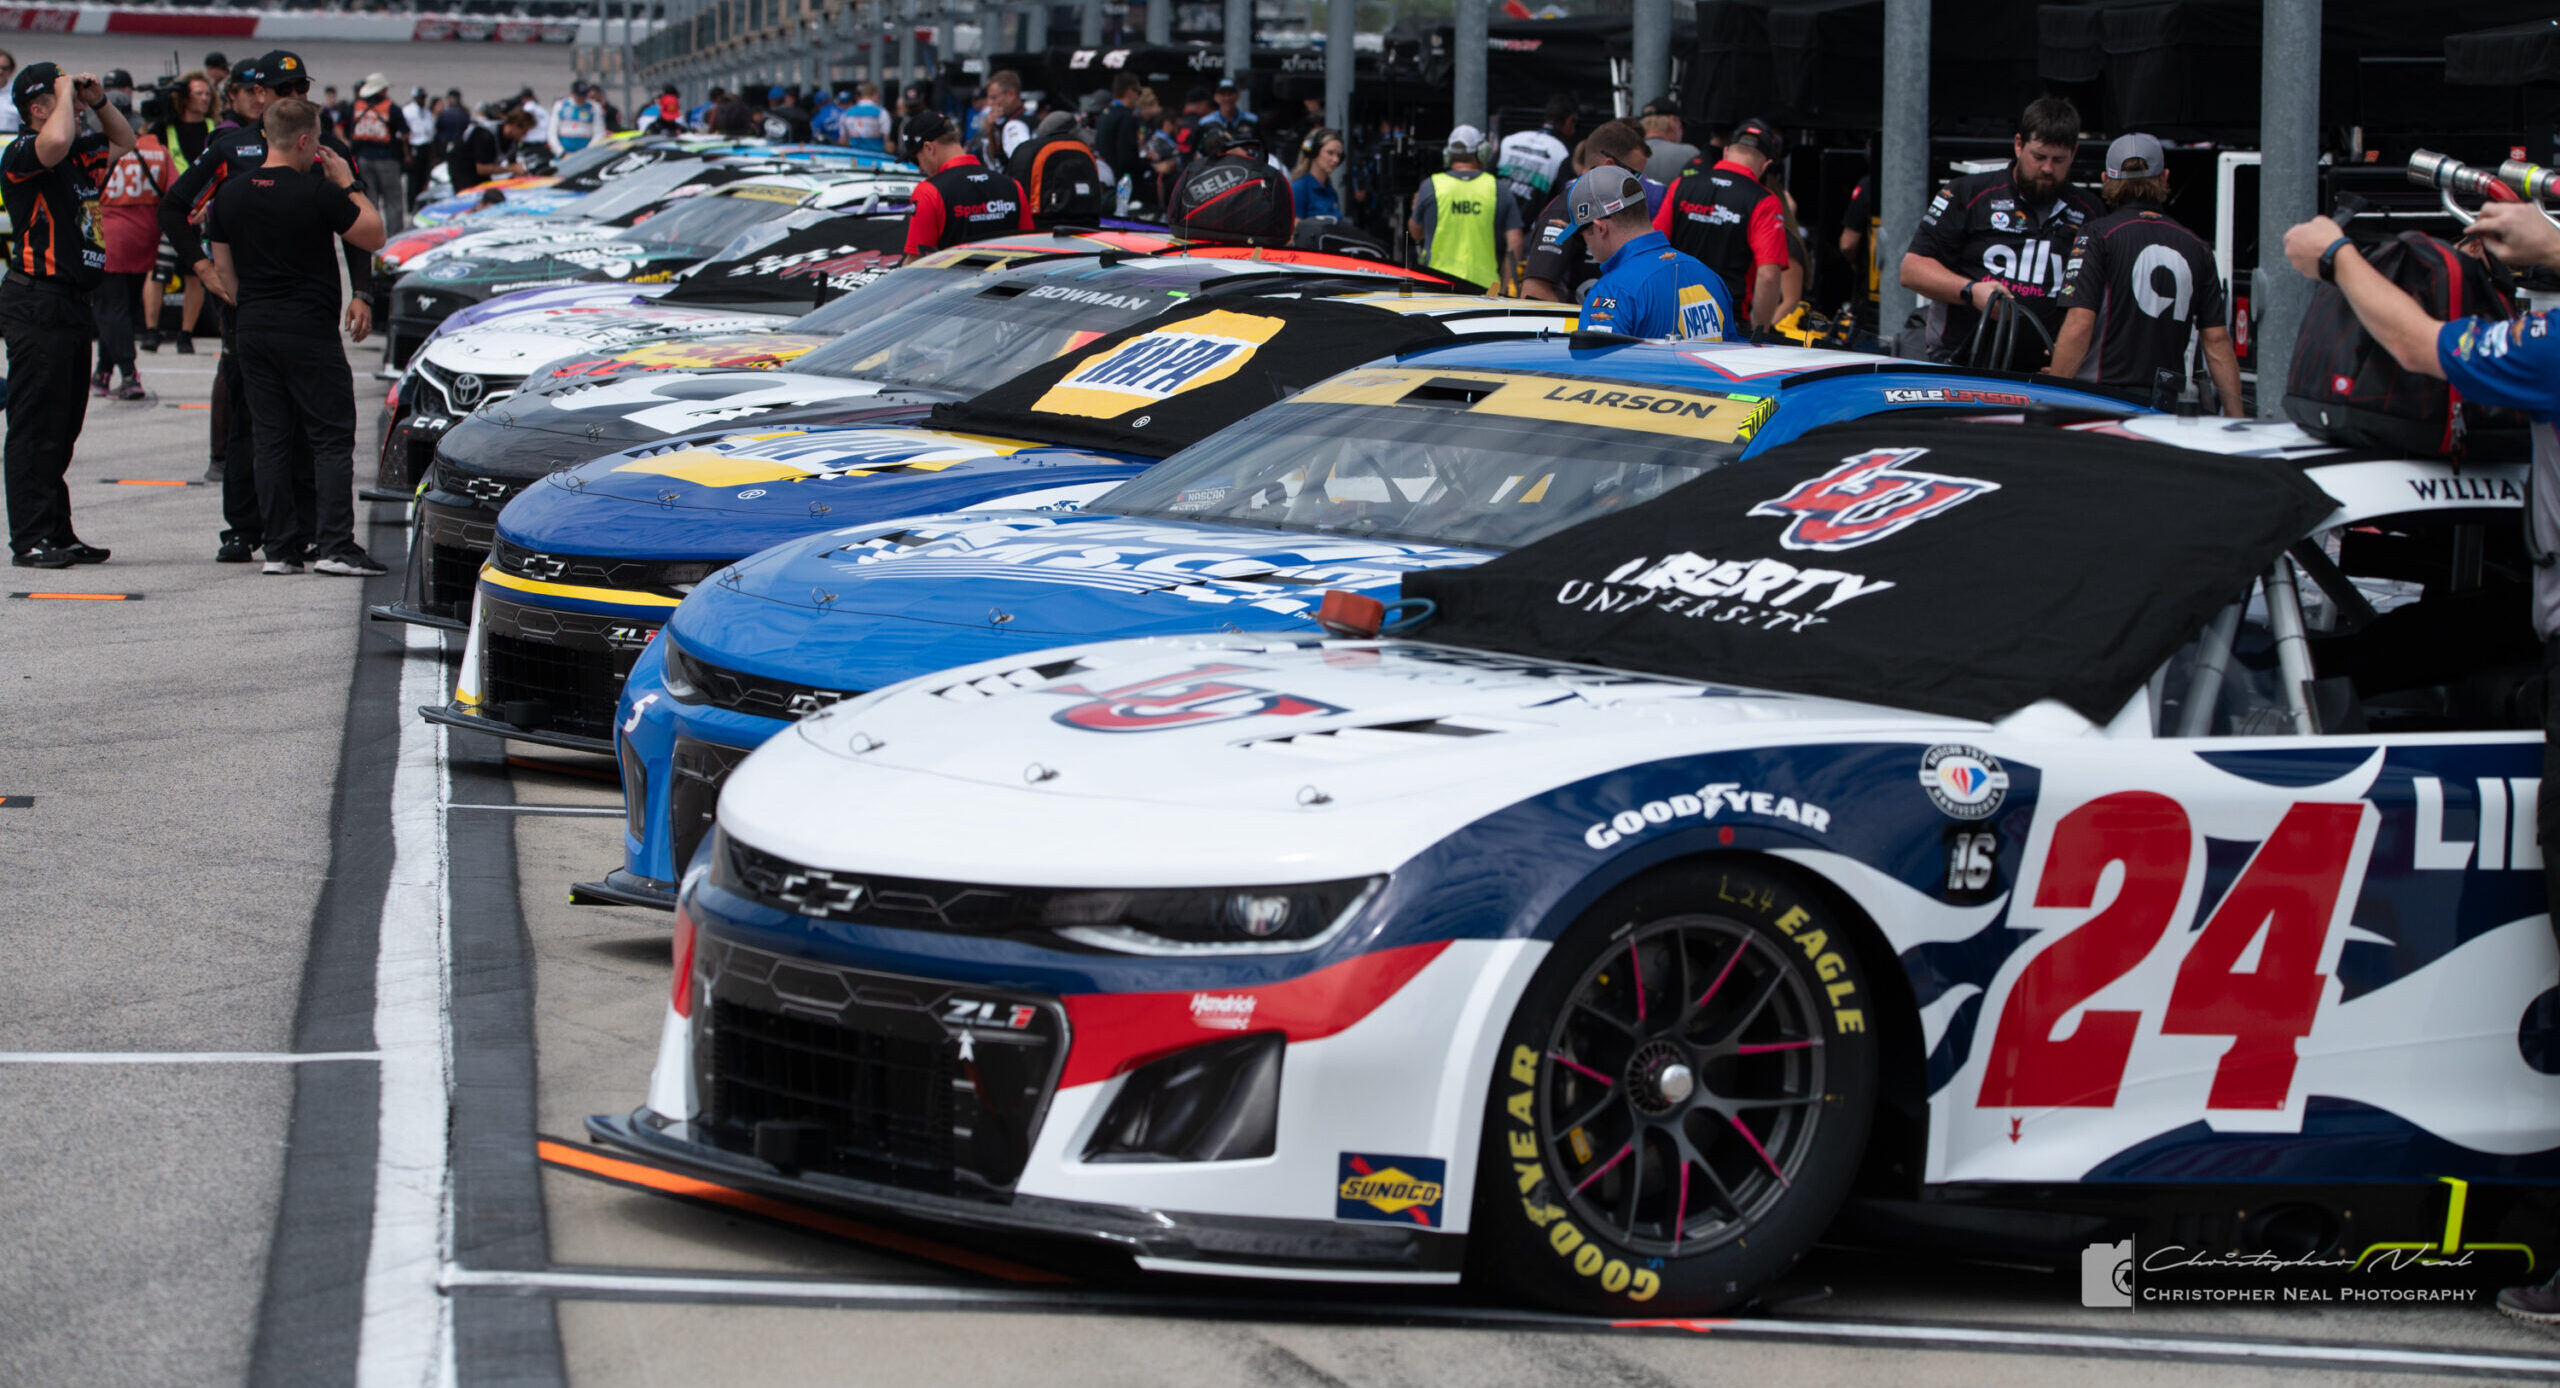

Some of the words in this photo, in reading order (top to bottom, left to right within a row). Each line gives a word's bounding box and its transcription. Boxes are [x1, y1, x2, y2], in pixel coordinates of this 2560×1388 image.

[1189, 170, 1240, 201] BELL
[1452, 201, 1481, 215] NBC
[1577, 203, 1590, 220] 9
[1028, 285, 1150, 311] BOWMAN
[1602, 298, 1616, 309] 75
[1682, 303, 1720, 337] NAPA
[1075, 336, 1241, 393] NAPA
[1543, 386, 1718, 419] LARSON
[1188, 489, 1226, 502] NASCAR
[1584, 782, 1831, 850] GOODYEAR
[1976, 790, 2366, 1111] 24
[1775, 904, 1866, 1035] EAGLE
[1507, 1044, 1662, 1302] GOODYEAR
[1345, 1180, 1438, 1202] SUNOCO
